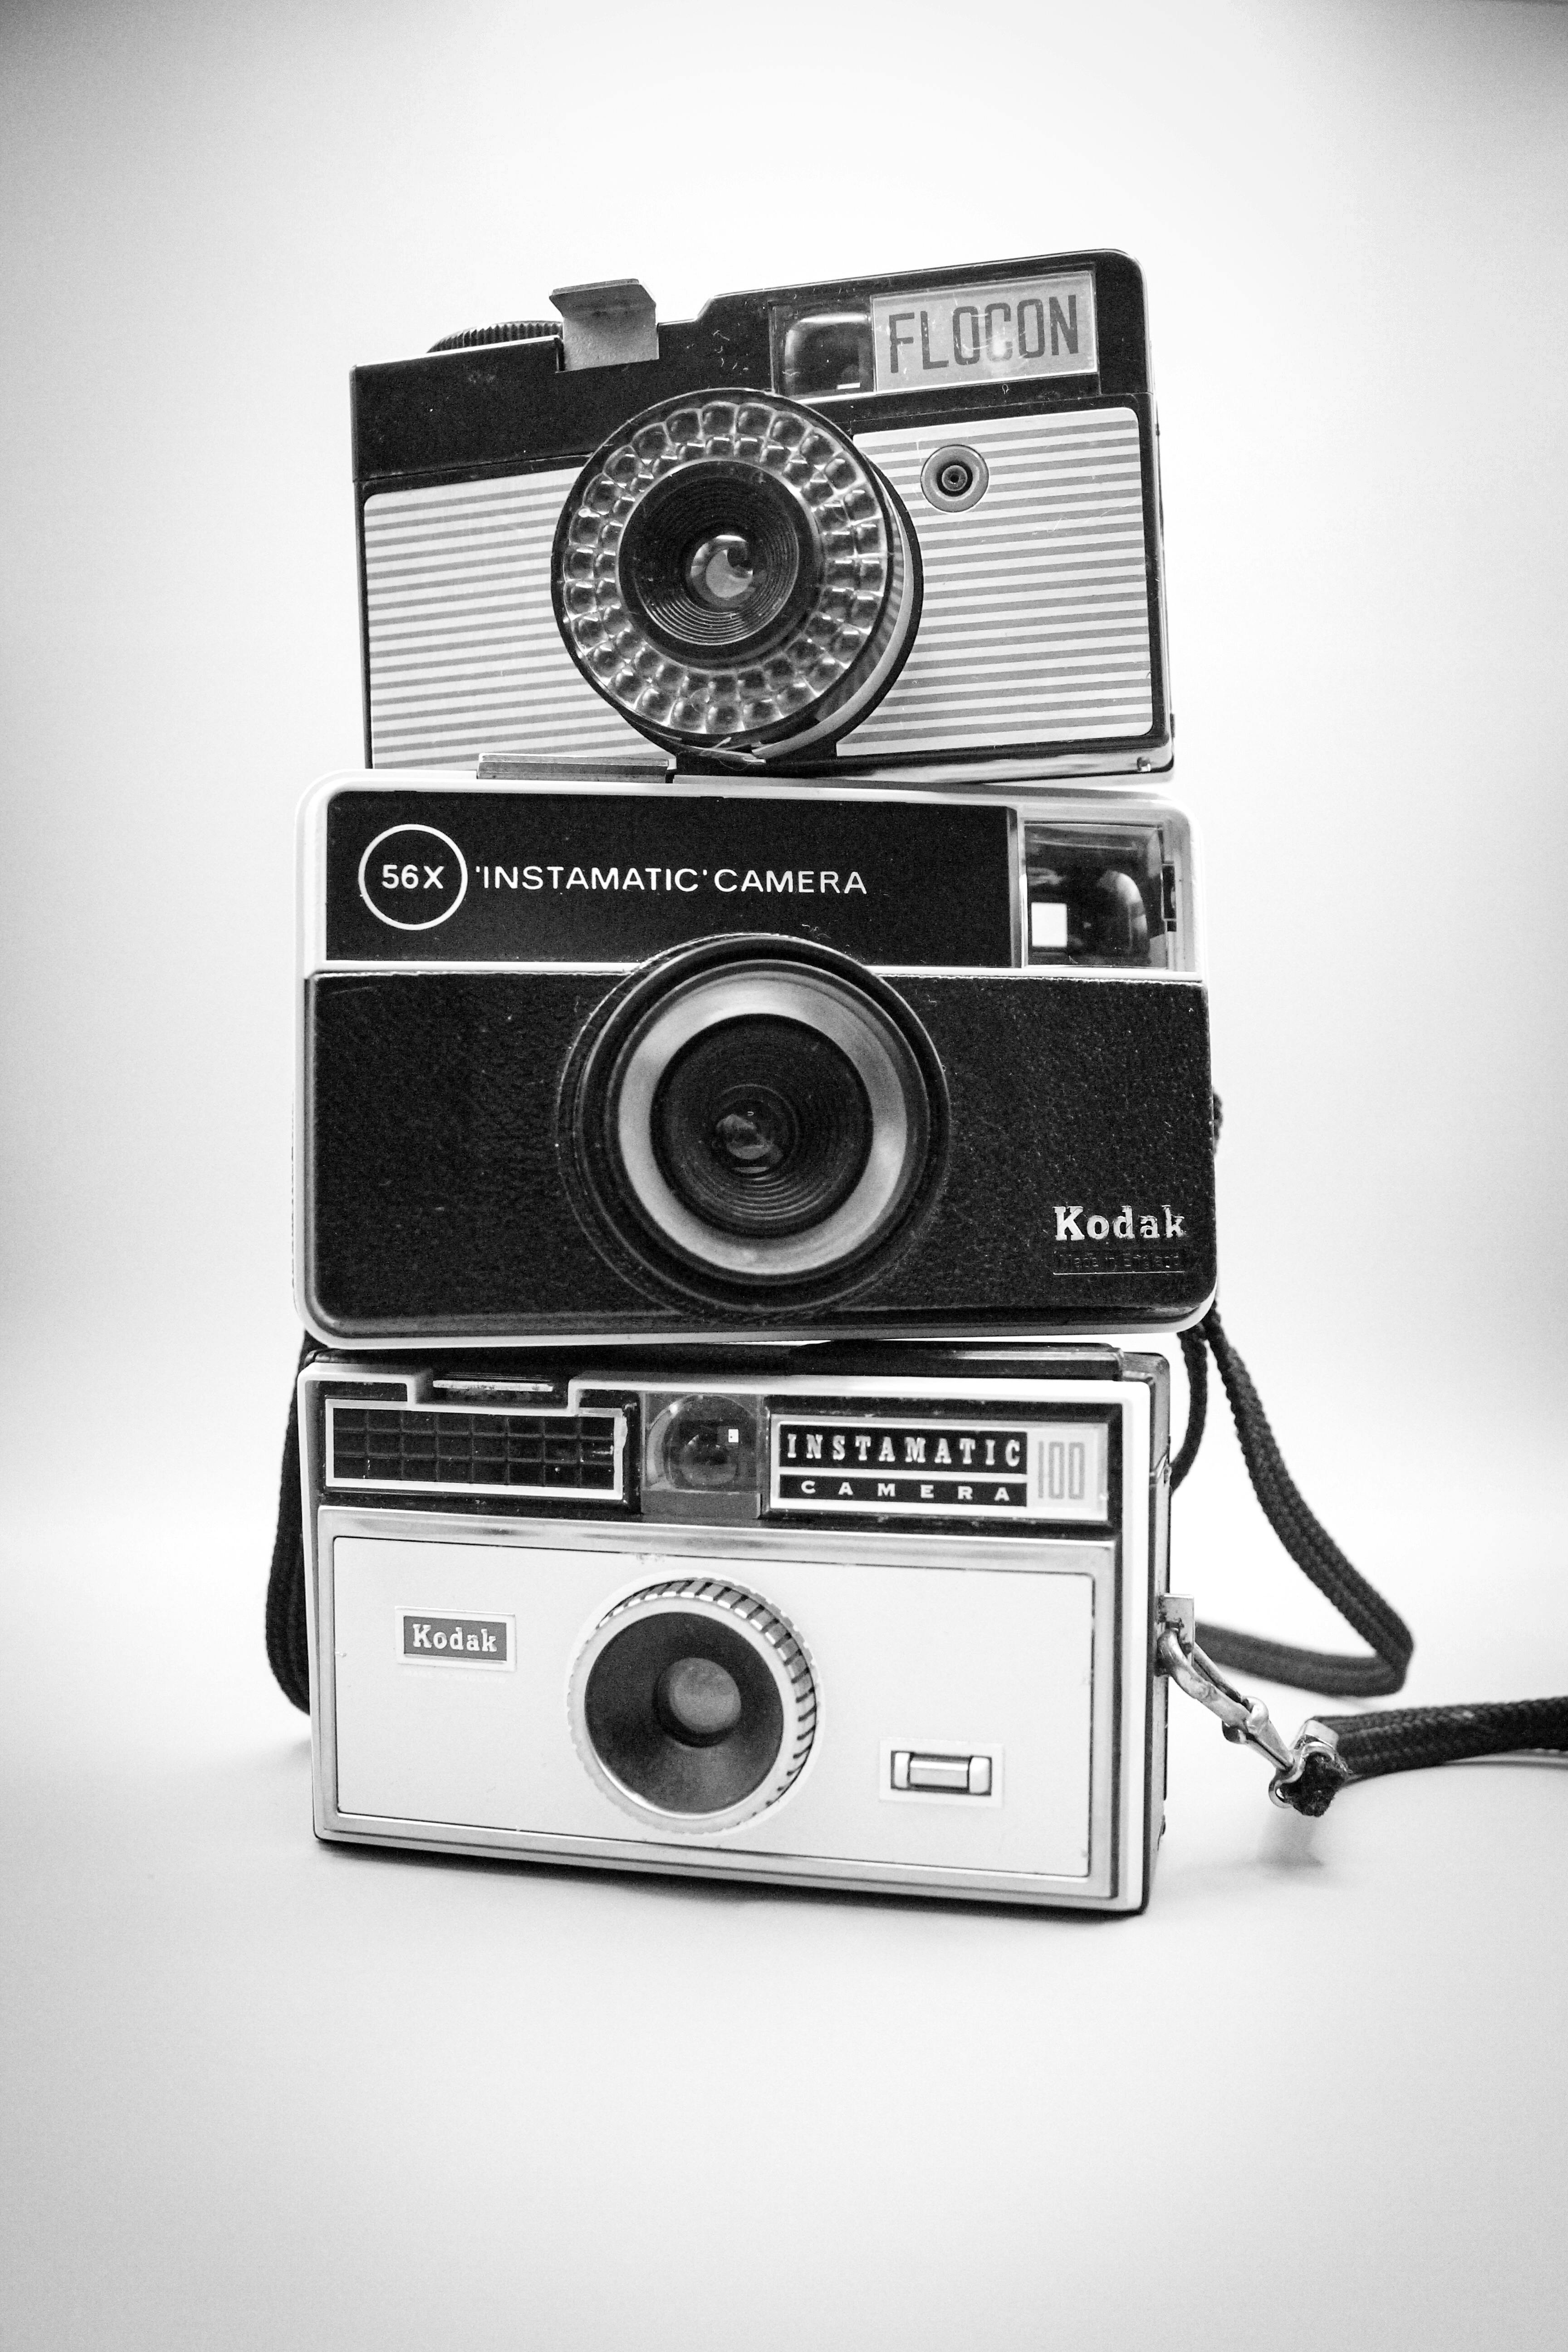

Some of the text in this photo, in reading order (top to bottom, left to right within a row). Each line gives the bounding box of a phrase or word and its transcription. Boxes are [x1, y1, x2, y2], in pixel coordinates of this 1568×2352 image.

[889, 294, 1079, 373] FLOCON
[382, 864, 444, 889] 56X
[714, 869, 867, 895] CAMERA
[1052, 1205, 1186, 1241] Kodak
[787, 1433, 1021, 1467] INSTAMATIC
[801, 1480, 1009, 1502] CAMERA
[412, 1623, 497, 1652] Kodak
